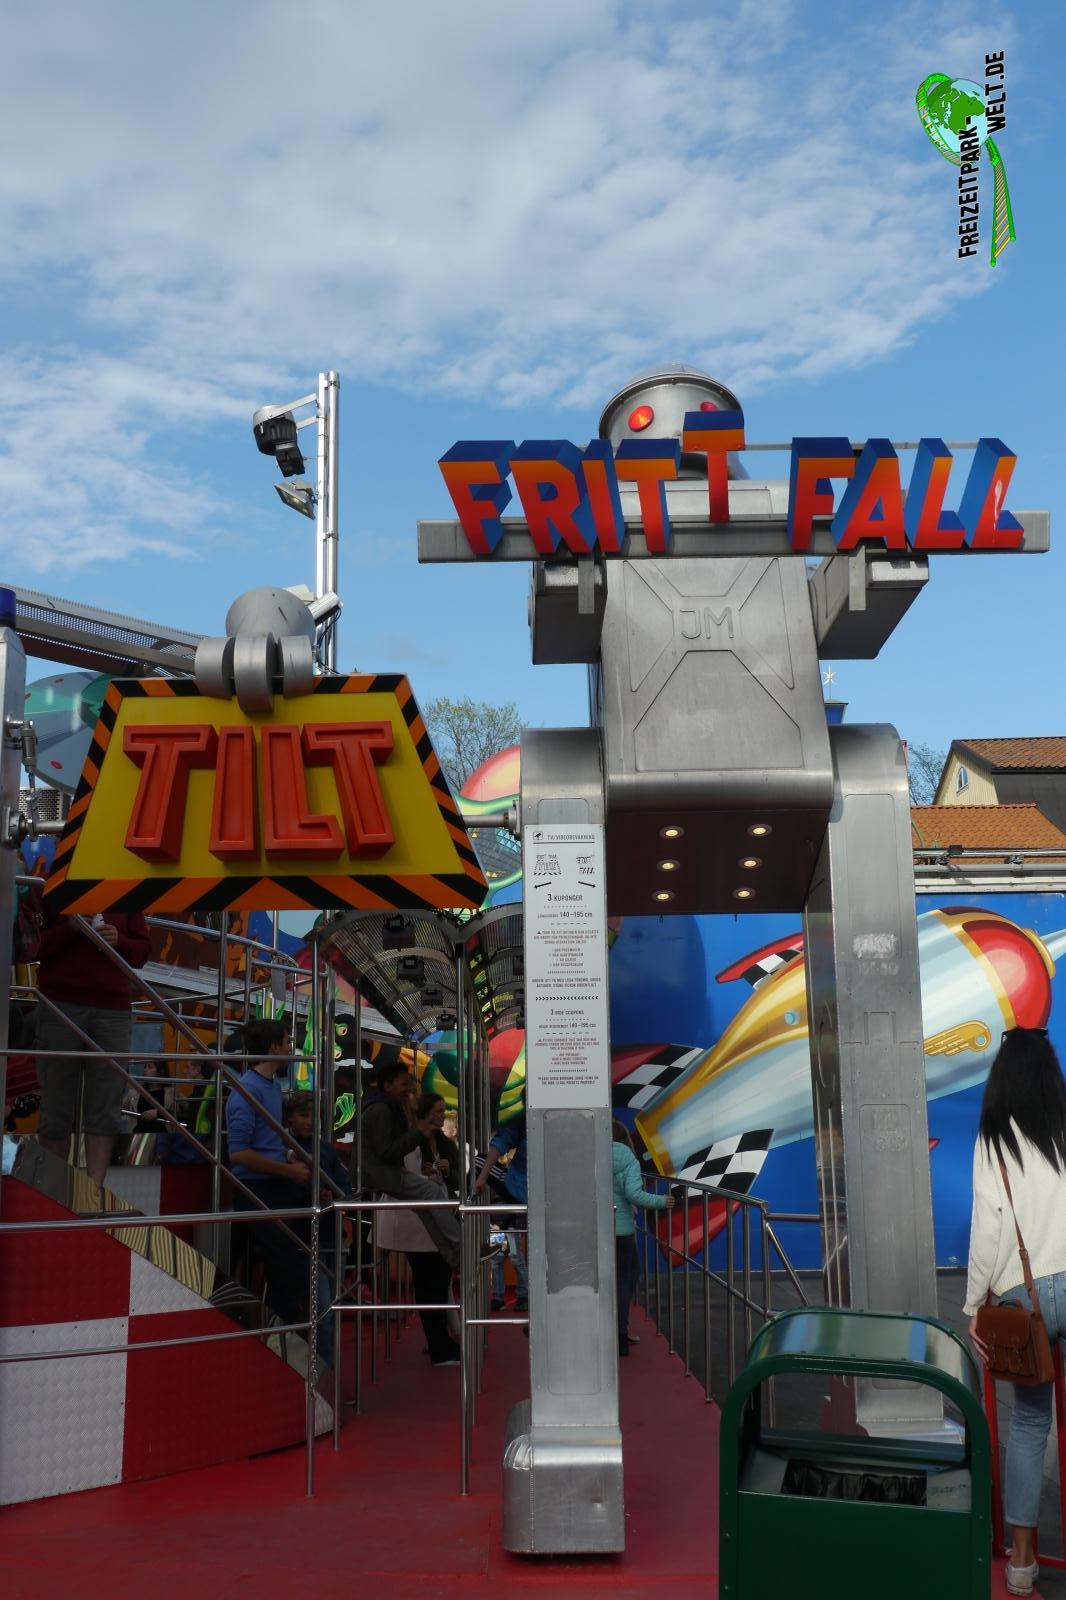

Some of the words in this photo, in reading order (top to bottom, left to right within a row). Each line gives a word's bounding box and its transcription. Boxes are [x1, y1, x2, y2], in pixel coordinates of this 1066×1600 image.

[438, 410, 745, 554] FRITT
[787, 437, 1024, 550] FALL
[679, 607, 734, 639] JM
[122, 721, 395, 864] TILT
[547, 893, 552, 902] 3
